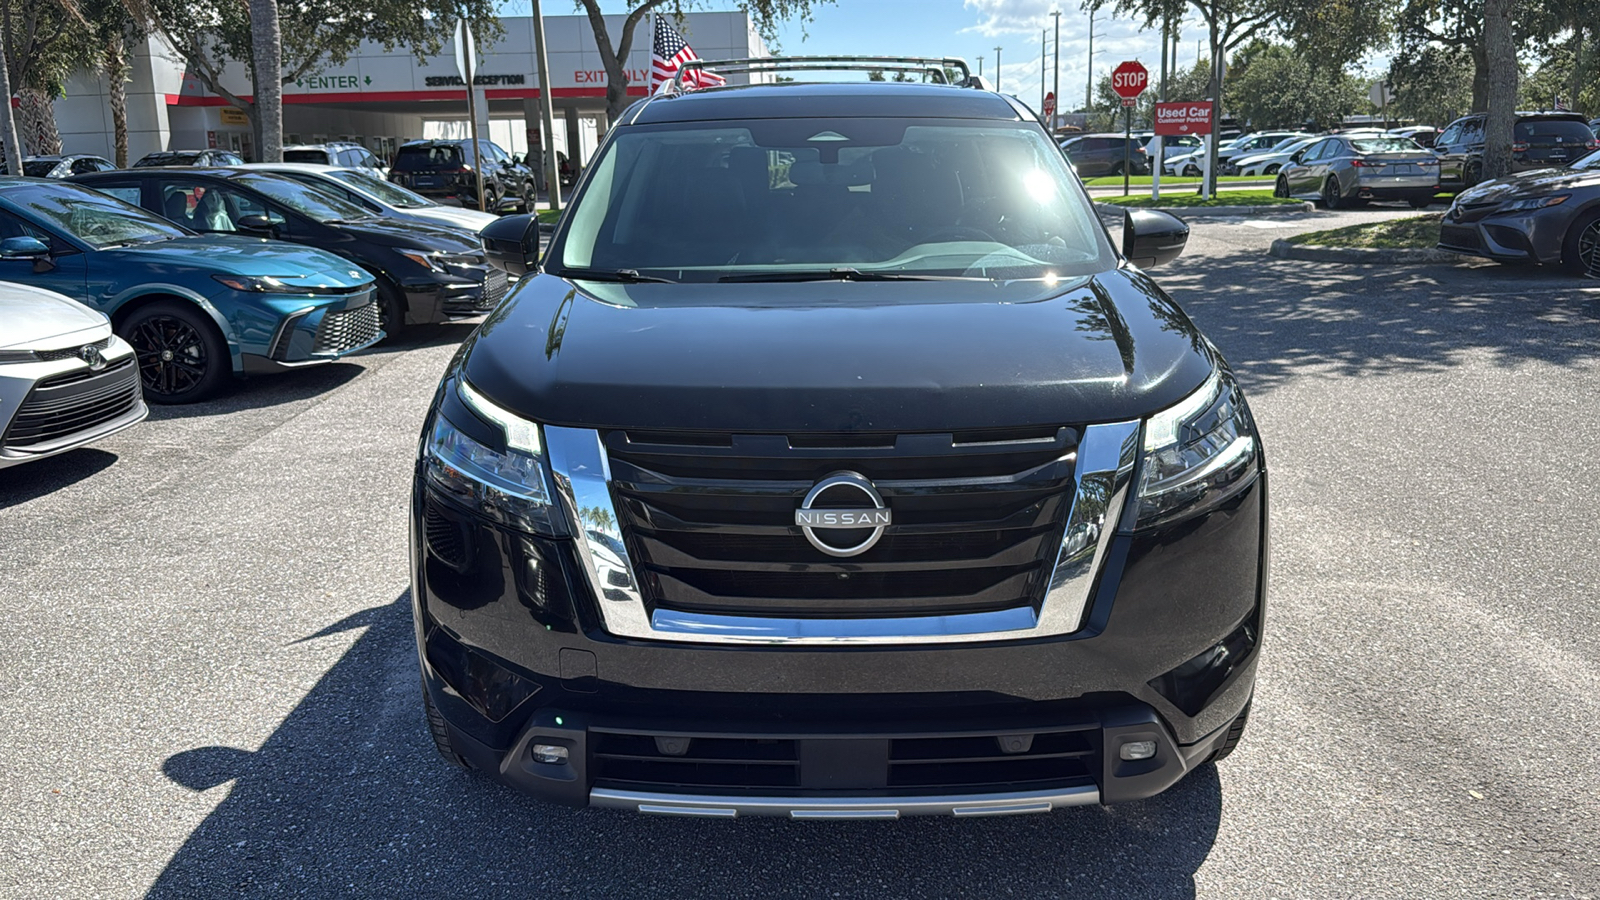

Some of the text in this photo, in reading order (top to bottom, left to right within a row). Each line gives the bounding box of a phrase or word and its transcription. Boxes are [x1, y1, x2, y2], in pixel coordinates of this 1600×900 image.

[309, 75, 359, 89] ENTER
[425, 75, 467, 87] SERVIC
[574, 69, 649, 83] EXIT NLY
[1114, 71, 1146, 88] STOP
[1157, 106, 1210, 118] Used Car
[798, 511, 889, 525] NISSAN
